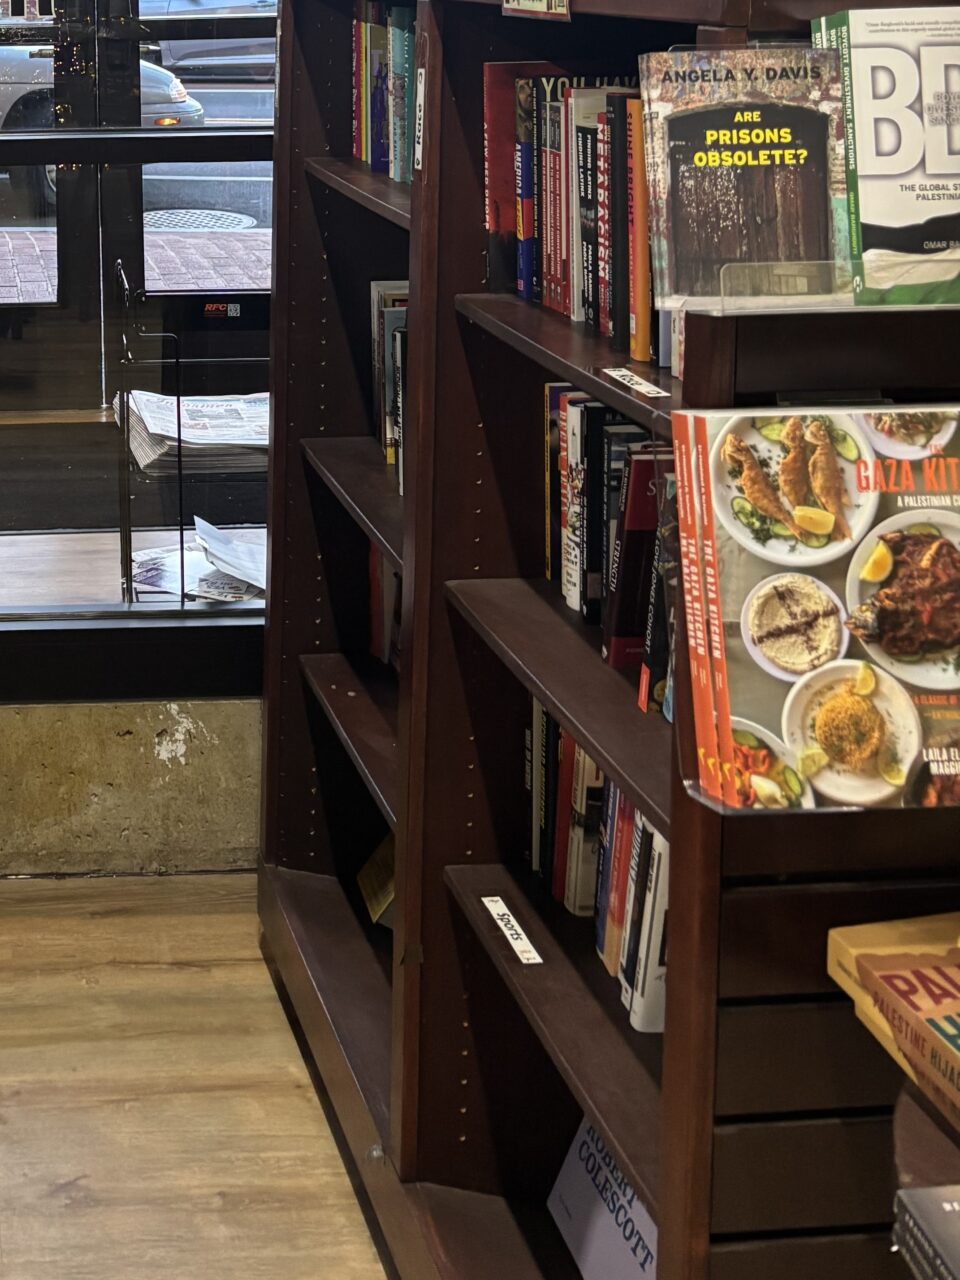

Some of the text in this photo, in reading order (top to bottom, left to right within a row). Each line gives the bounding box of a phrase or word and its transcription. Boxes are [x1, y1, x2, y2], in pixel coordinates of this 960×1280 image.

[662, 66, 821, 83] ANGELA Y. DAVIS
[844, 67, 852, 120] DIVESTMENT
[734, 112, 761, 122] ARE
[705, 128, 792, 145] PRISONS
[694, 149, 807, 167] OBSOLETE?
[899, 184, 916, 192] THE
[918, 183, 950, 192] GLOBAL
[923, 241, 947, 249] OMAR
[856, 457, 960, 494] GAZA KIT
[897, 495, 902, 507] A
[904, 495, 951, 507] PALESTINIAN
[610, 540, 622, 592] STRENGTH
[682, 553, 691, 587] GAZA
[690, 560, 699, 594] GAZA
[645, 539, 660, 654] LOVE JONES COHORT
[704, 539, 722, 659] THE GAZA KITCHEN
[685, 590, 696, 648] KITCHEN
[694, 597, 705, 656] KITCHEN
[922, 747, 948, 761] LAILA
[497, 911, 523, 942] Sports
[873, 990, 927, 1058] PALESTINE
[578, 1140, 655, 1272] COLESCOTT
